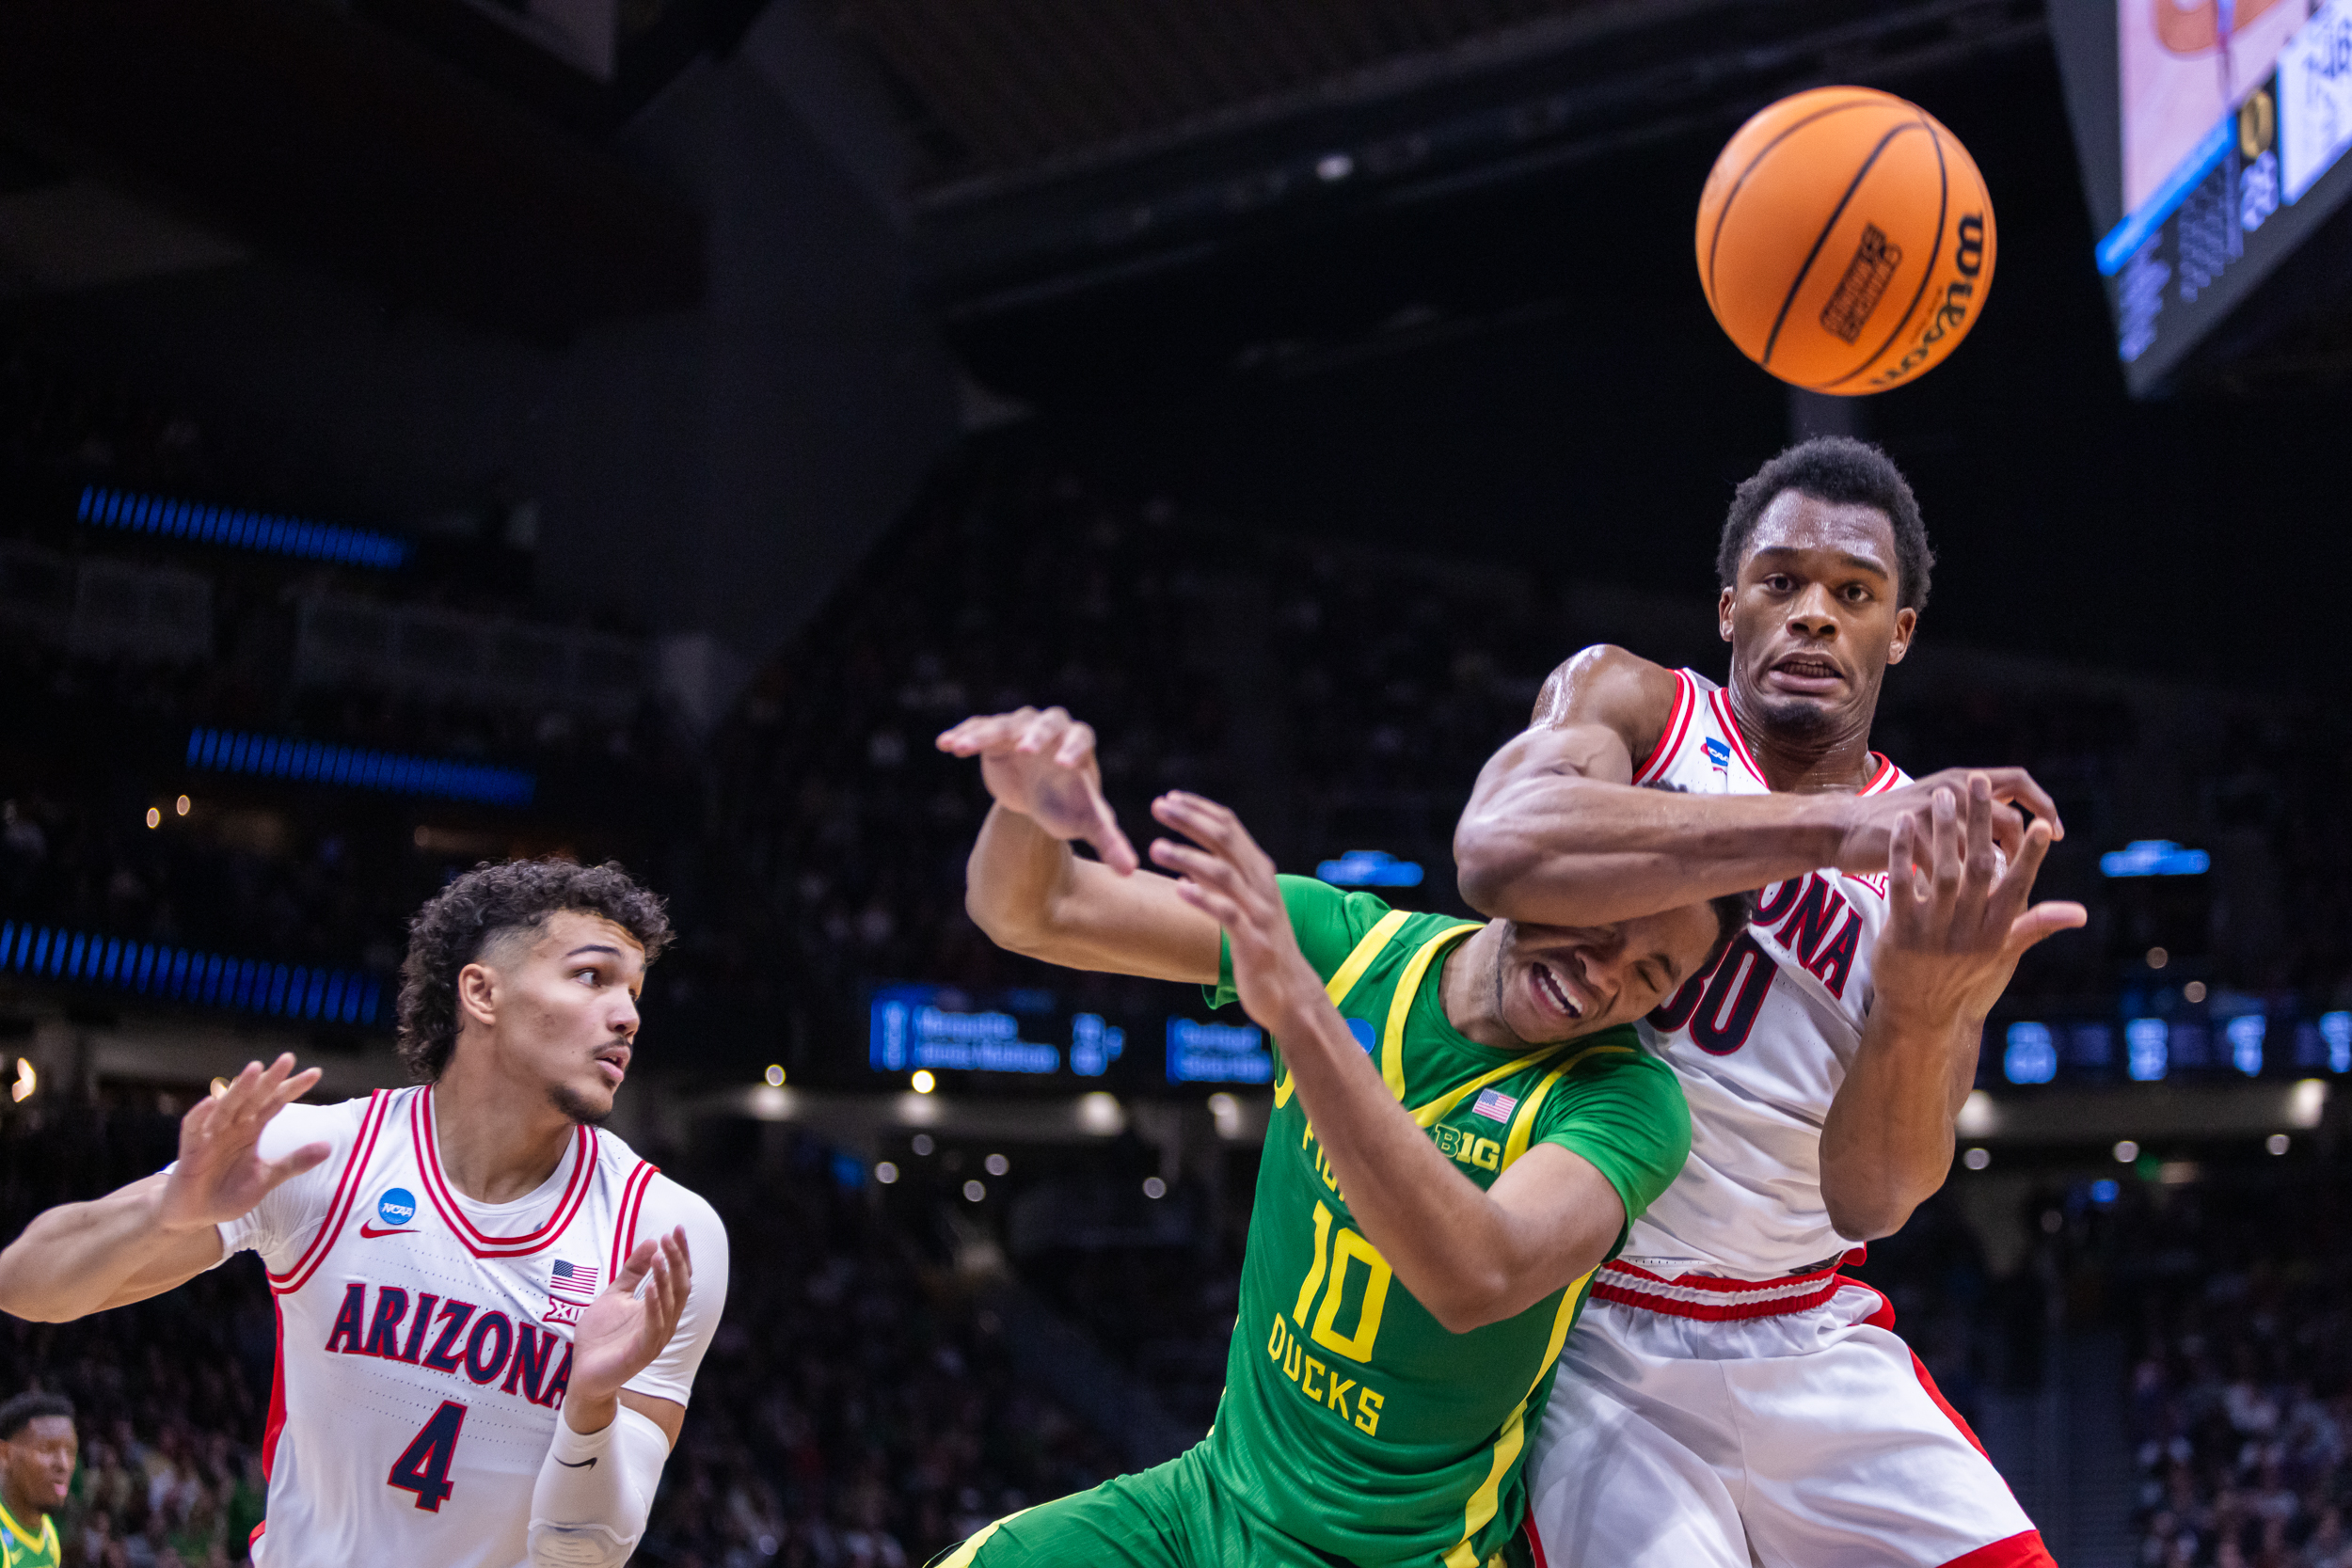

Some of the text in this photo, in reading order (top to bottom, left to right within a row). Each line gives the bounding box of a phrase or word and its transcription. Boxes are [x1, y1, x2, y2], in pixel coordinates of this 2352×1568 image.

[1708, 746, 1729, 763] CAA
[382, 1202, 414, 1217] NCAA
[1292, 1199, 1392, 1364] 10
[325, 1283, 575, 1411] ARIZONA
[1267, 1312, 1385, 1437] DUCKS
[387, 1400, 469, 1513] 4
